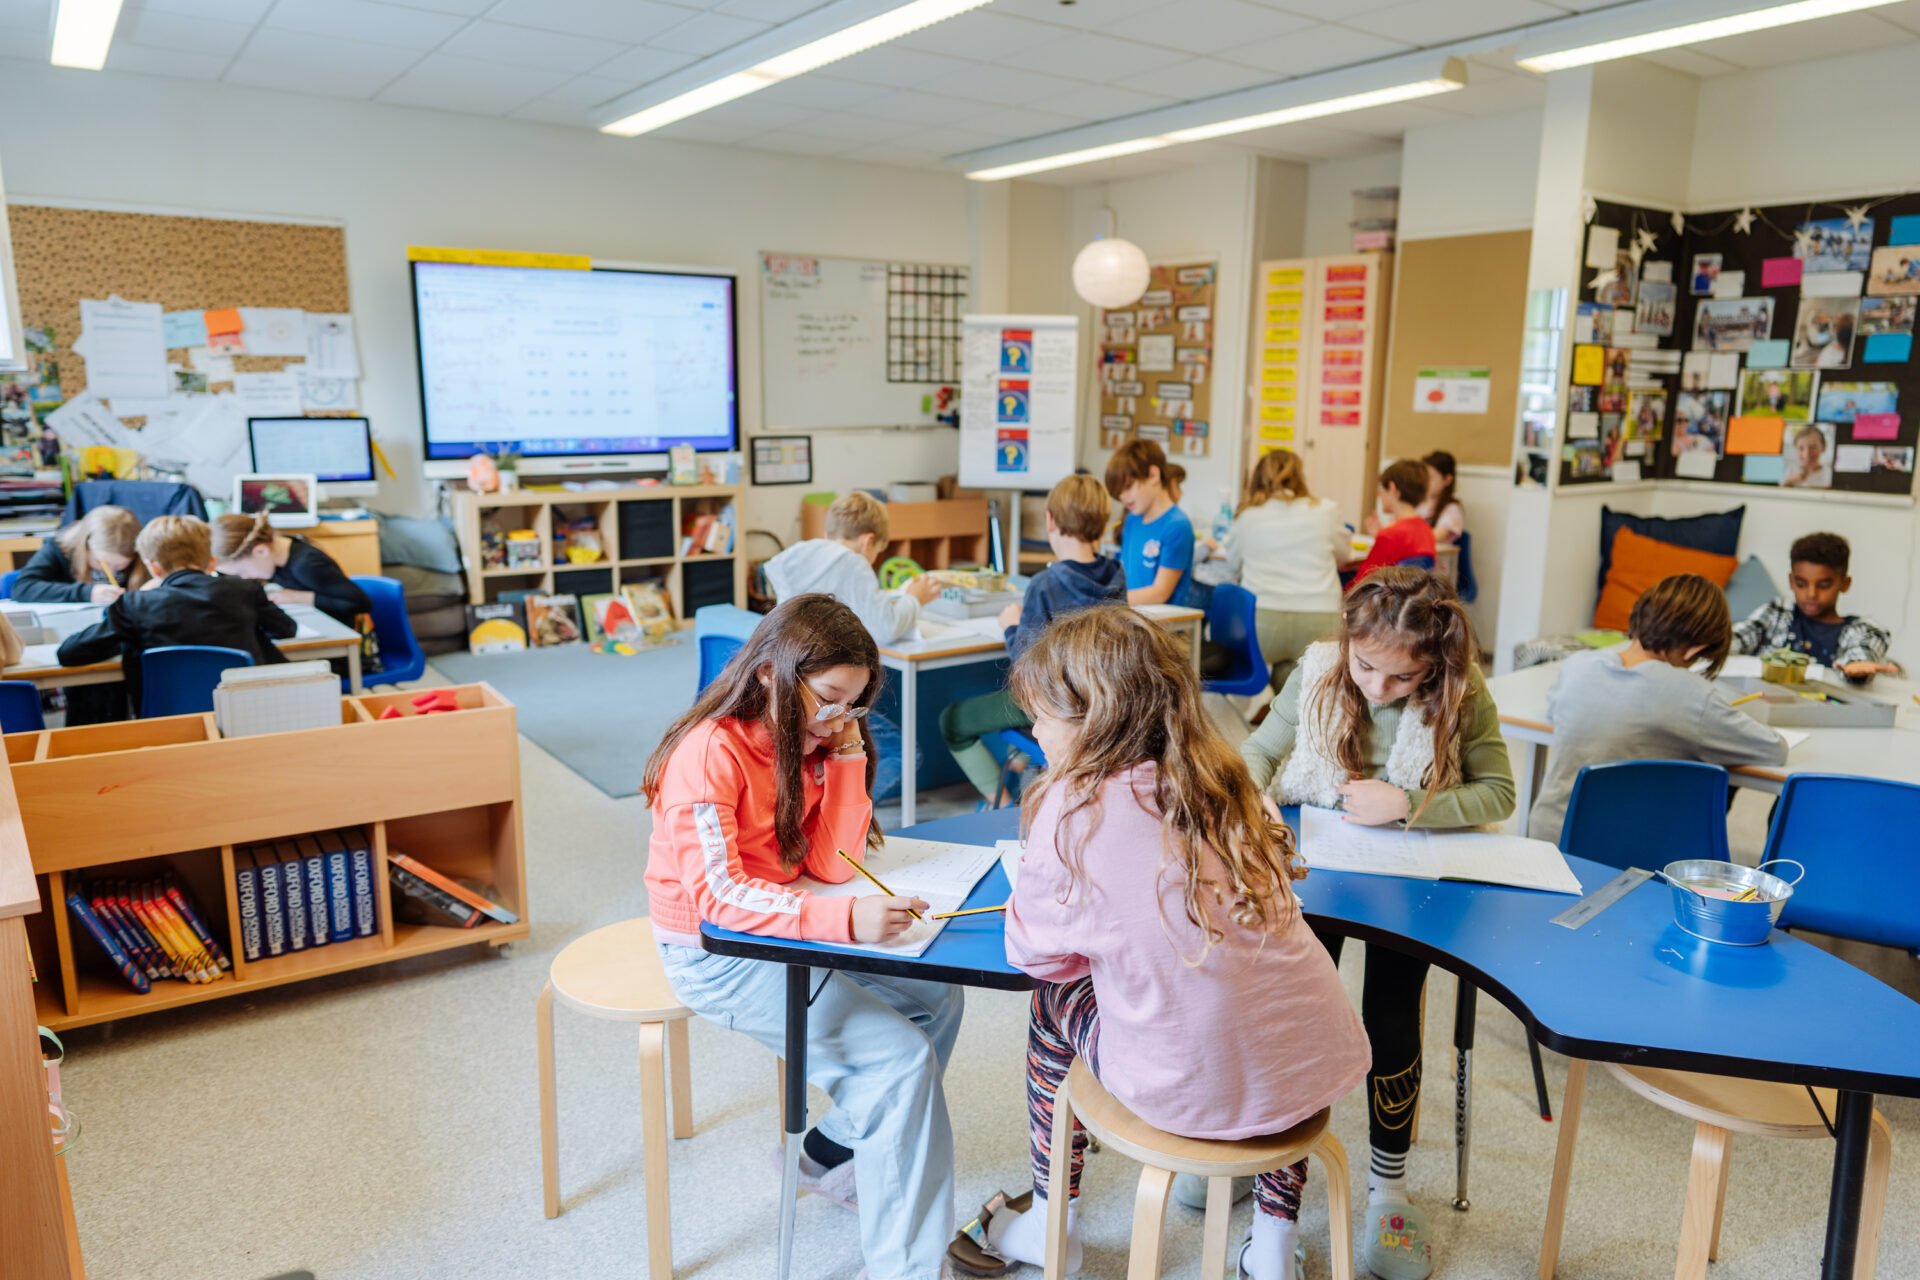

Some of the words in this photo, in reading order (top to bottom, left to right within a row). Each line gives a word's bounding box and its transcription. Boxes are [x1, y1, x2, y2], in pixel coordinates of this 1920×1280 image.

[238, 872, 256, 917] OXFORD
[261, 868, 279, 913] OXFORD
[284, 863, 301, 907] OXFORD
[307, 859, 324, 903] OXFORD
[330, 855, 346, 898] OXFORD
[353, 851, 369, 895] OXFORD
